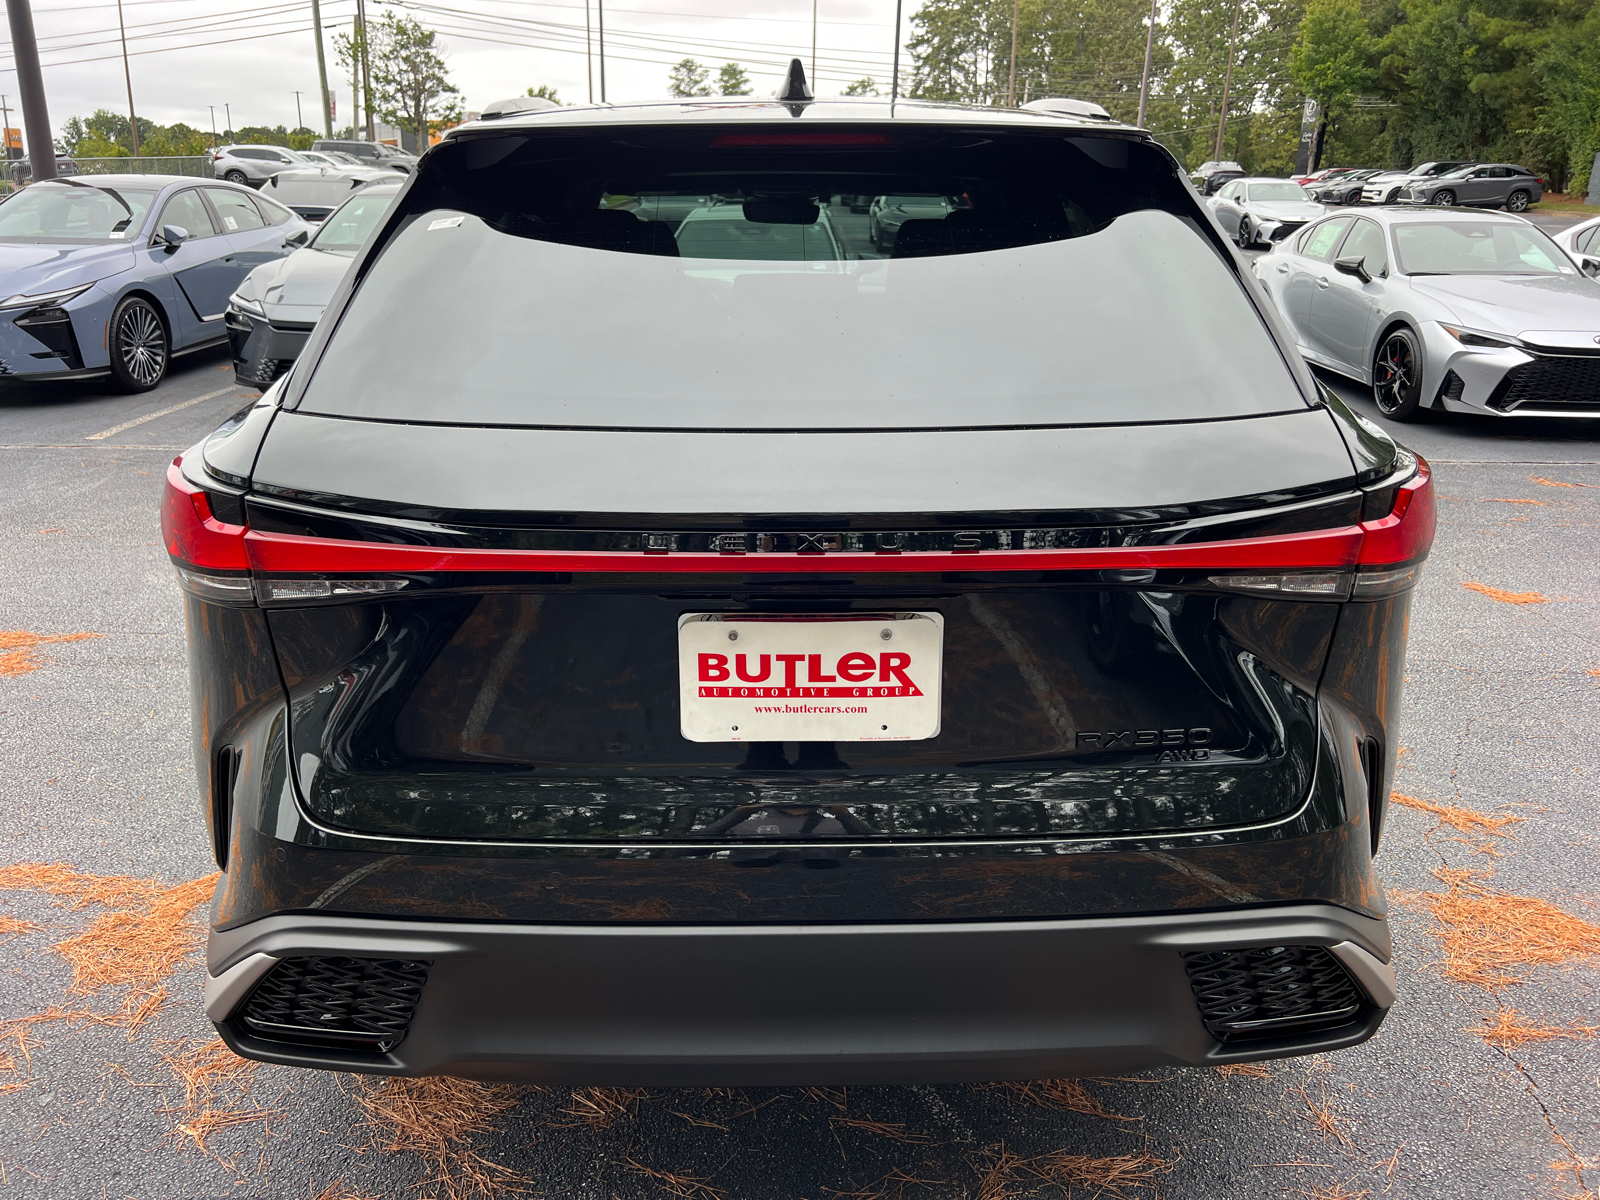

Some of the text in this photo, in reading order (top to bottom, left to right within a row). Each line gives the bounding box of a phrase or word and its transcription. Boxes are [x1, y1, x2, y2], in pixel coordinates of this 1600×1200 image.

[641, 532, 982, 551] LEXUS
[699, 687, 917, 697] AUTOMOTIVE GROUP
[754, 704, 868, 714] www.butlercars.com
[1155, 749, 1210, 763] AWD
